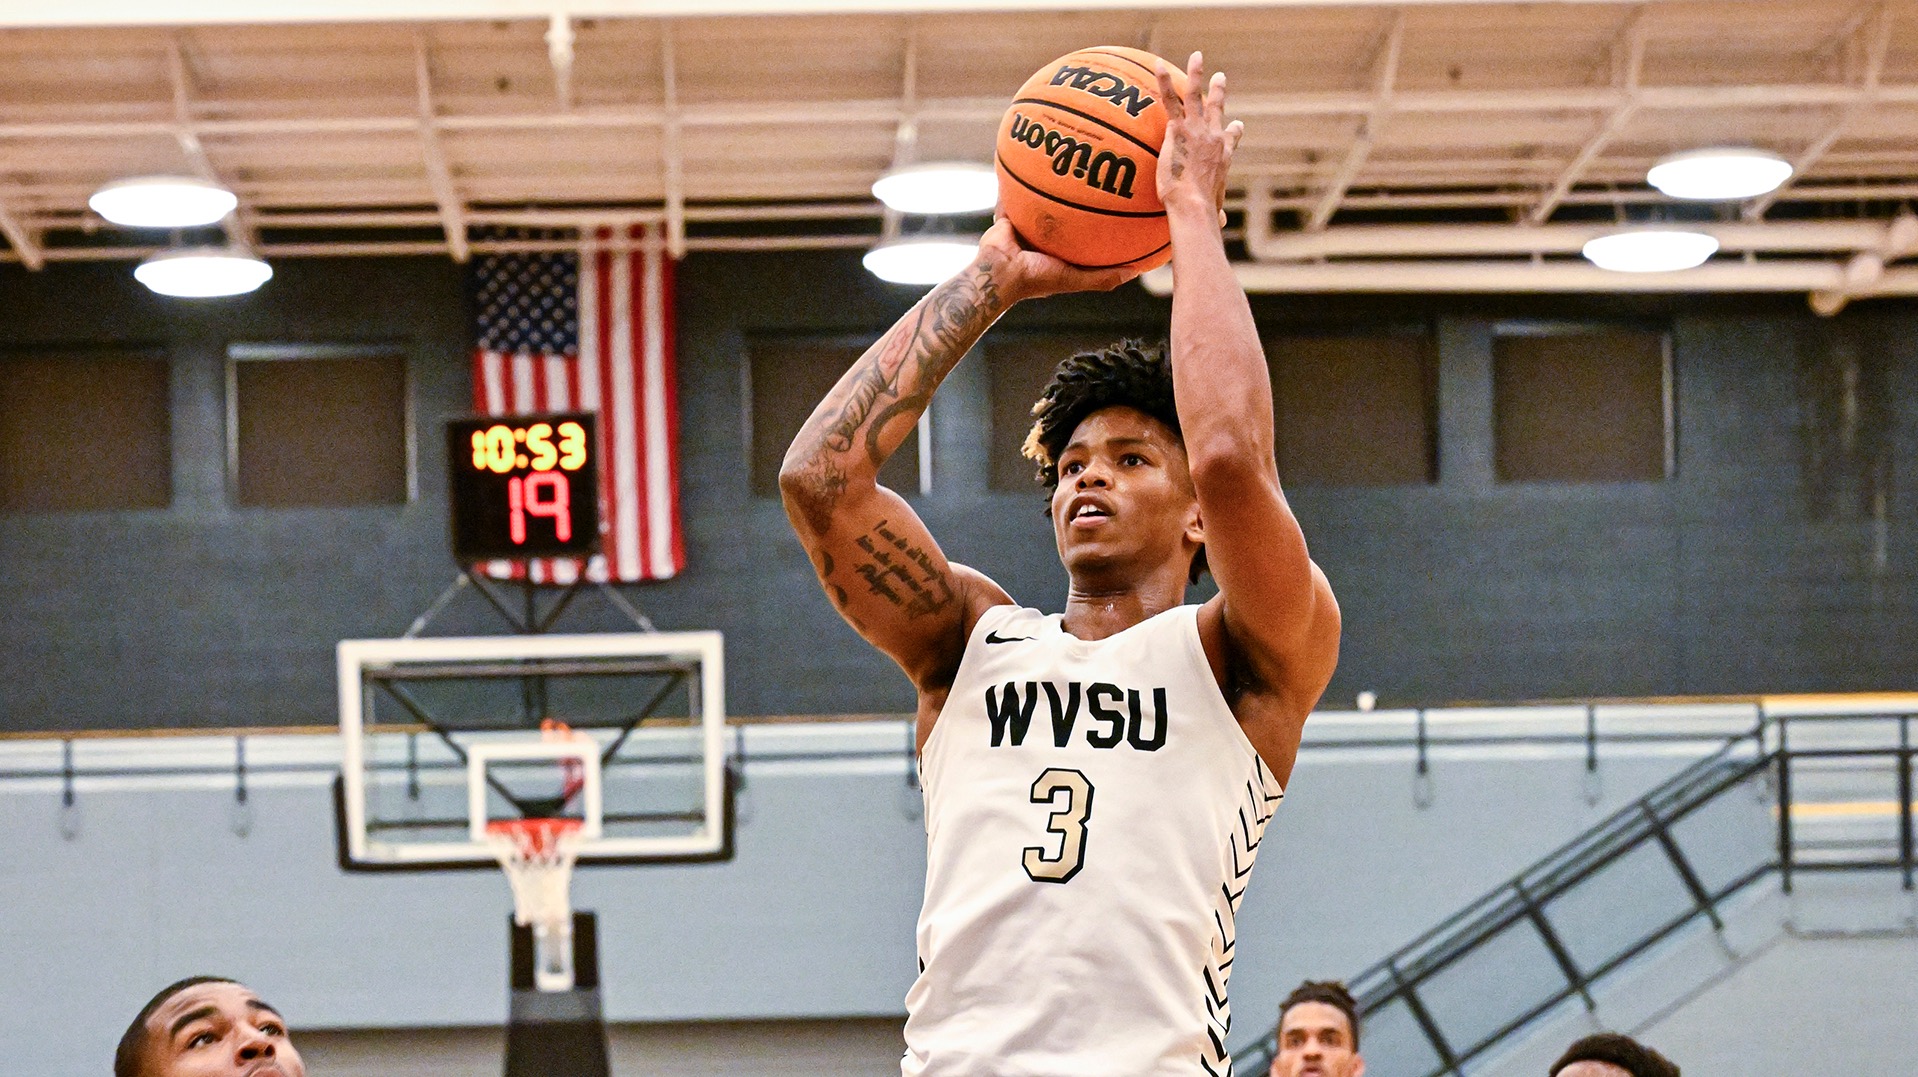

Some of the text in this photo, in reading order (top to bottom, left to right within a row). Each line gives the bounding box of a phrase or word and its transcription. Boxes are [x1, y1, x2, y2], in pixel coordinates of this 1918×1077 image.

[1050, 65, 1154, 117] NCAA
[1010, 113, 1137, 199] Wilson
[471, 421, 587, 474] 10:53
[508, 470, 572, 545] 19
[985, 681, 1168, 752] WVSU
[1021, 767, 1095, 884] 3
